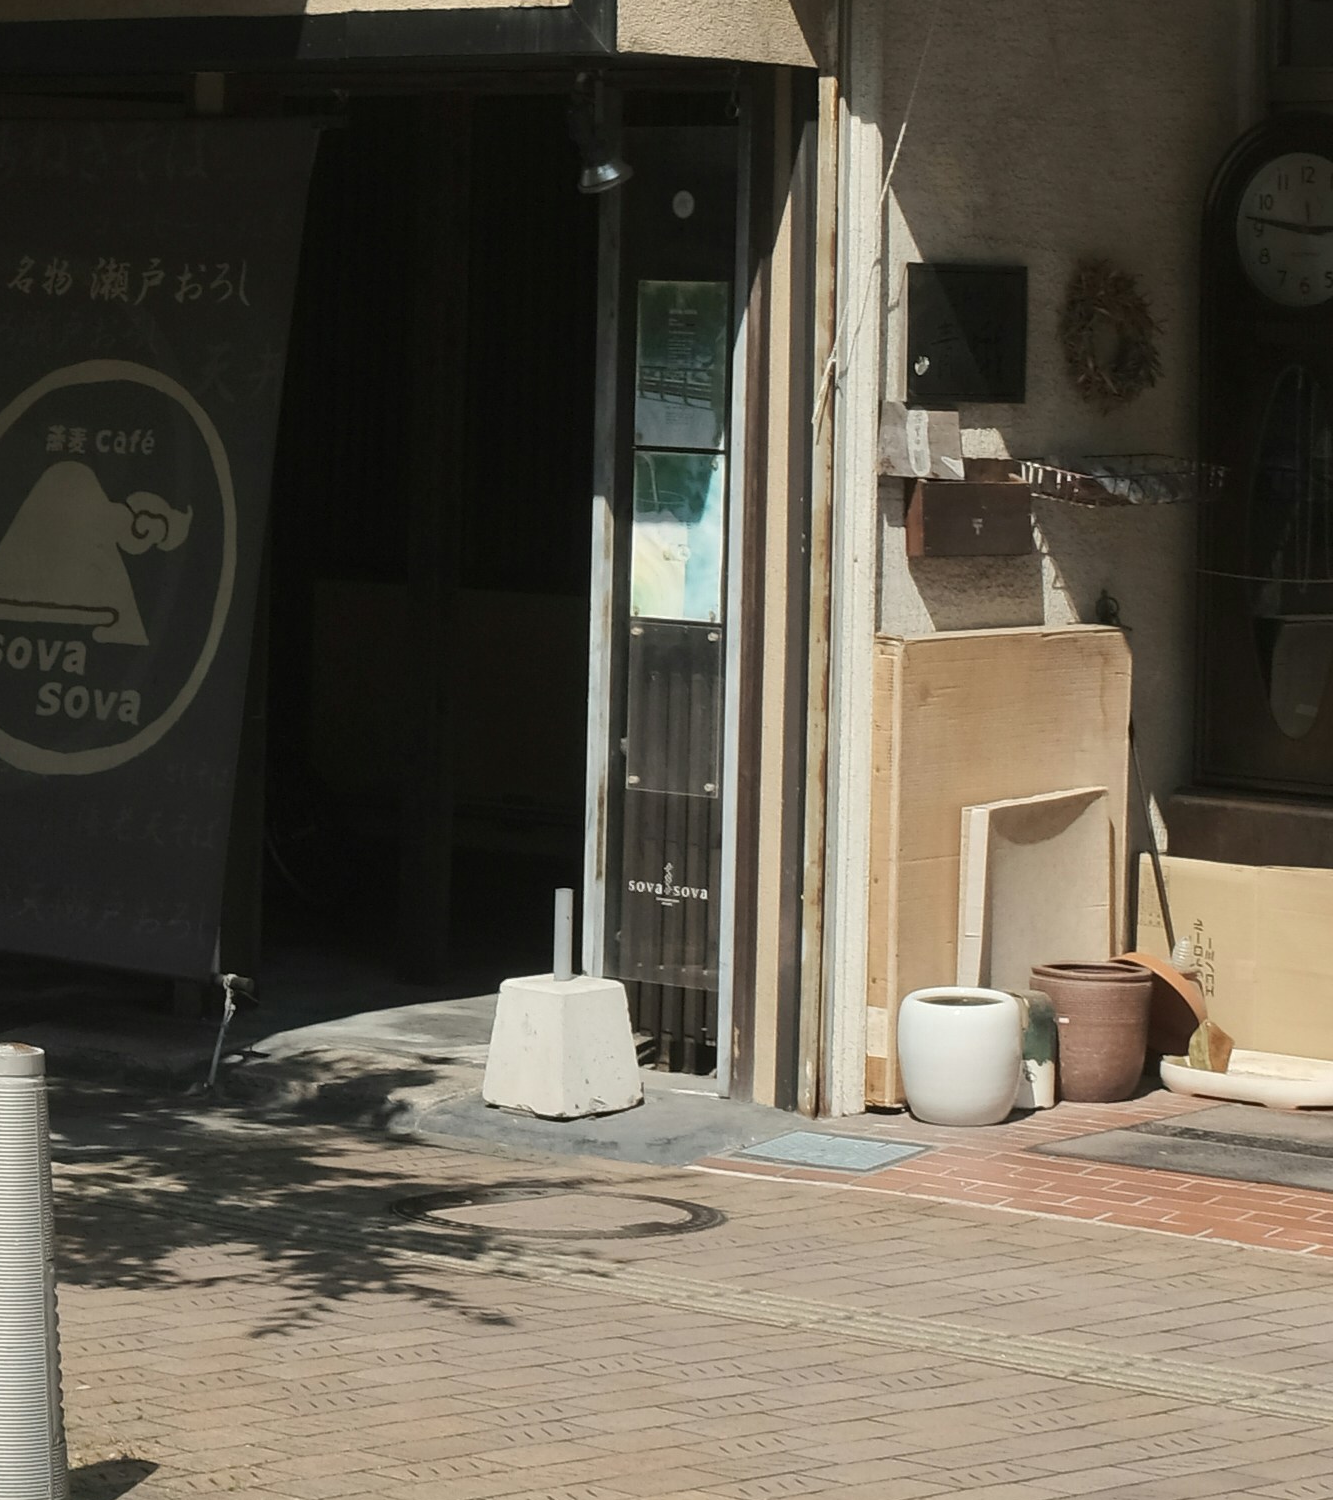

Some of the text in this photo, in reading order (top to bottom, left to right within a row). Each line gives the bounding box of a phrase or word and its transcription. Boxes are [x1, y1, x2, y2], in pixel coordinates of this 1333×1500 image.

[1276, 168, 1289, 191] 11
[1300, 165, 1316, 184] 12
[1259, 193, 1274, 211] 10
[1259, 247, 1271, 264] 8
[6, 254, 251, 307] 名物 瀬戸おろし
[1277, 269, 1287, 287] 7
[1299, 276, 1311, 295] 6
[34, 681, 142, 726] sova
[628, 879, 709, 900] sova sova
[1205, 937, 1215, 997] エコノミー
